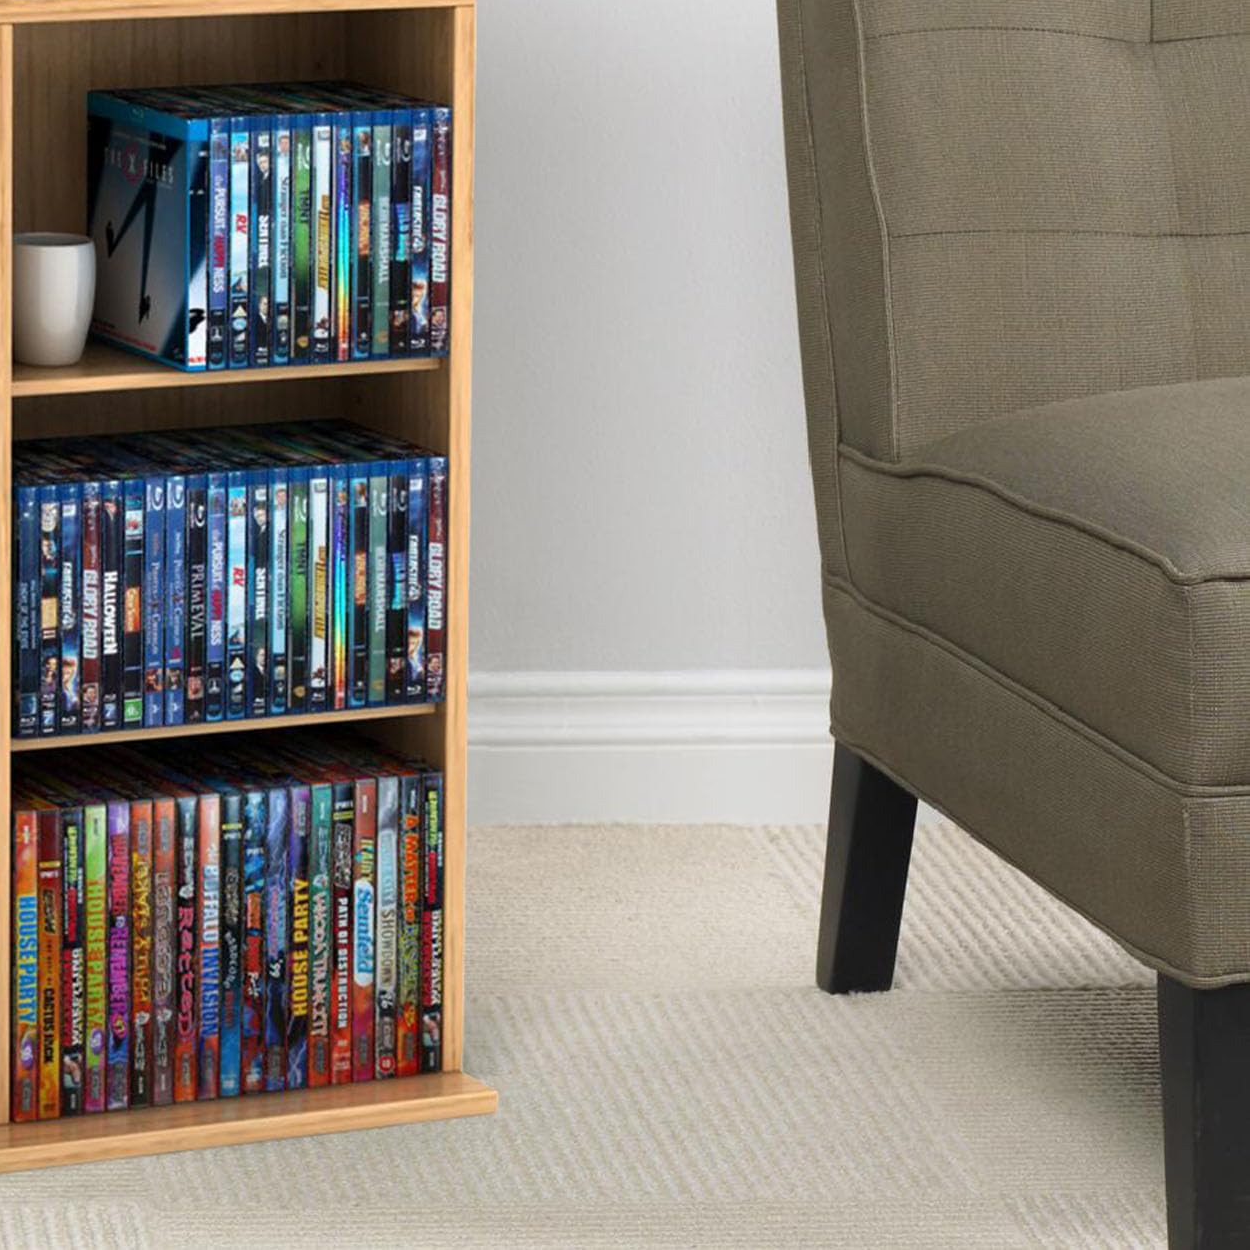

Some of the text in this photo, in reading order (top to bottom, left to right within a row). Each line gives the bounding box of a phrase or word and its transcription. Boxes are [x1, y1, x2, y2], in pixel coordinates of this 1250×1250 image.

[214, 188, 225, 228] PURSUIT
[236, 214, 247, 234] RV
[432, 194, 446, 282] GLORY ROAD
[378, 225, 389, 284] MARSHALL
[192, 564, 204, 640] PRIMEVAL
[211, 542, 223, 581] PURSUIT
[233, 568, 244, 587] RV
[428, 543, 443, 630] GLORY ROAD
[83, 570, 98, 659] GLORY ROAD
[103, 571, 117, 654] HALLOWEEN
[404, 814, 419, 902] A MATTER
[86, 884, 105, 1022] HOUSE PARTY
[201, 865, 220, 1038] BUFFALO INVASION
[292, 878, 308, 1016] HOUSE PARTY
[337, 897, 348, 930] PATH
[338, 933, 348, 946] OF
[356, 889, 373, 974] Seinfeld
[380, 909, 395, 985] SHOWDOWN
[18, 896, 37, 1023] HOUSE PARTY
[109, 928, 127, 1011] REMEMBER
[337, 948, 348, 1028] DESTRUCTION
[43, 988, 55, 1032] CACTUS
